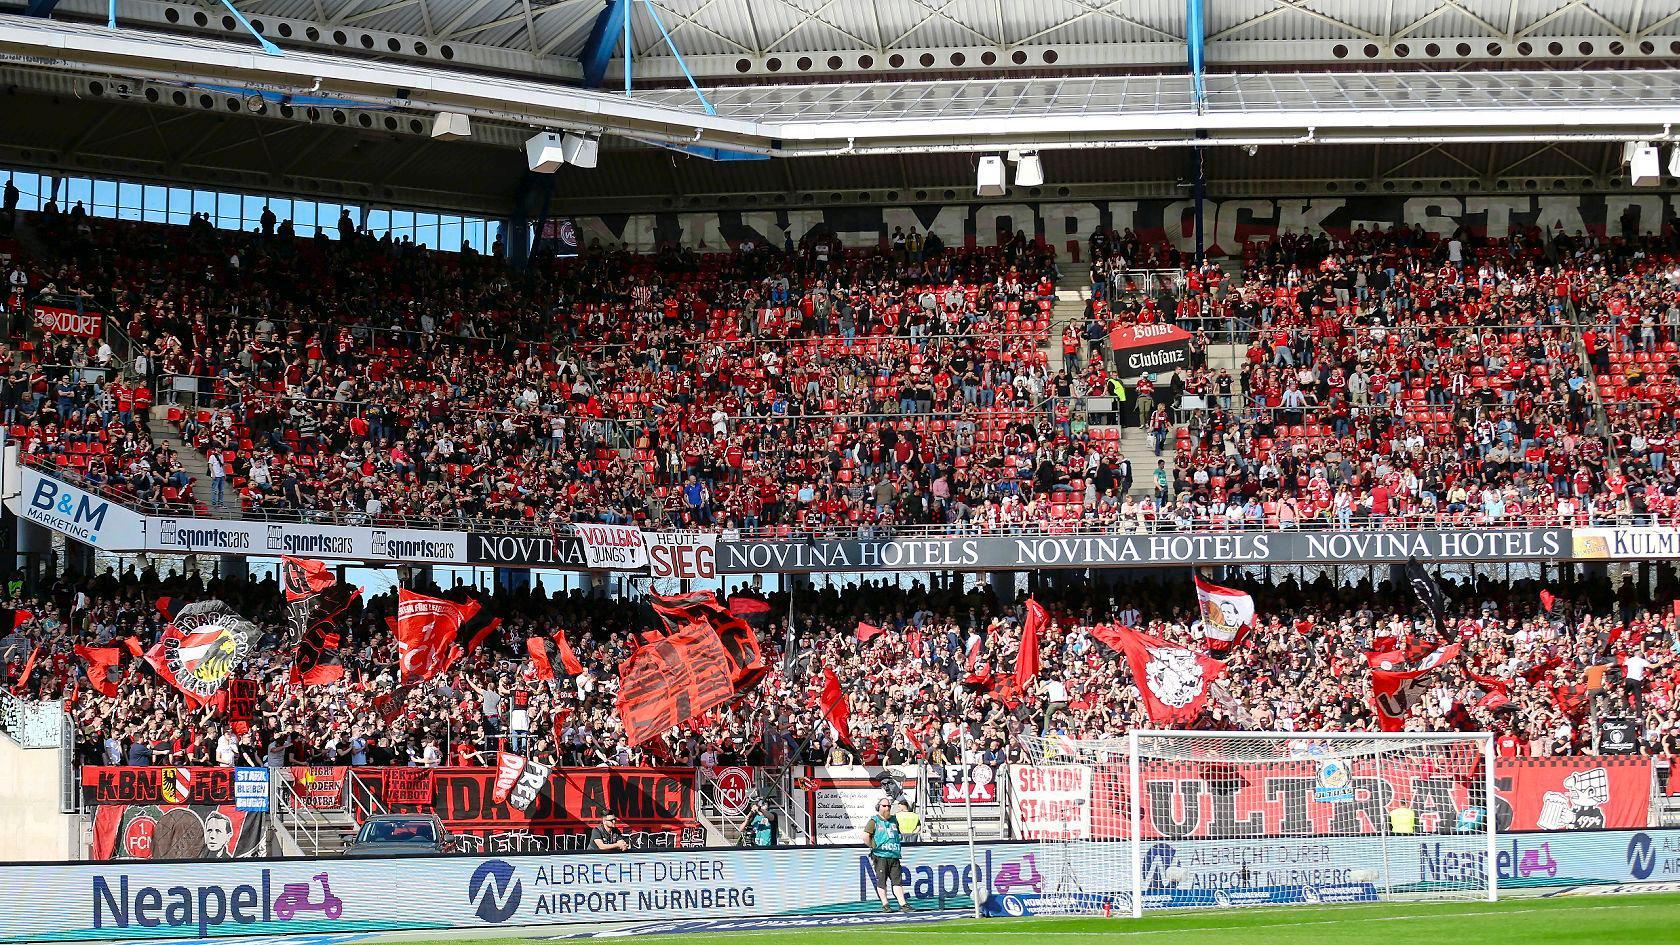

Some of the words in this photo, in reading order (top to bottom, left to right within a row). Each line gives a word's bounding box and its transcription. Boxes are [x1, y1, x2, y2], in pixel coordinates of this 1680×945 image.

[1128, 349, 1185, 369] Clubfanz
[31, 477, 109, 531] B&M
[27, 508, 90, 540] MARKETING
[177, 529, 250, 549] sportscars
[283, 533, 353, 556] sportscars
[388, 537, 455, 560] sportscars
[479, 535, 586, 564] NOVINA
[582, 527, 642, 548] VOLLGAS
[656, 533, 701, 546] HEUTE
[1015, 538, 1141, 565] NOVINA
[1148, 534, 1270, 561] HOTELS
[1306, 532, 1433, 559] NOVINA
[1438, 531, 1559, 557] HOTELS
[1613, 530, 1680, 555] KULM
[651, 545, 715, 579] SIEG
[728, 541, 849, 569] NOVINA
[861, 540, 979, 567] HOTELS
[310, 767, 334, 776] FIGHT
[1018, 767, 1083, 792] SEKTION
[98, 769, 157, 800] KBN
[720, 788, 743, 803] FCN
[580, 774, 697, 822] AMICI
[1019, 799, 1082, 823] STADION
[1576, 815, 1602, 829] 1994
[881, 842, 901, 851] HOST
[1190, 845, 1271, 866] ALBRECHT
[1662, 836, 1680, 852] AL
[534, 862, 646, 886] ALBRECHT
[653, 859, 724, 882] DÜRER
[859, 849, 992, 911] Neapel
[1190, 870, 1262, 890] AIRPORT
[93, 868, 271, 937] Neapel
[534, 890, 632, 915] AIRPORT
[638, 886, 755, 912] NÜRNBERG
